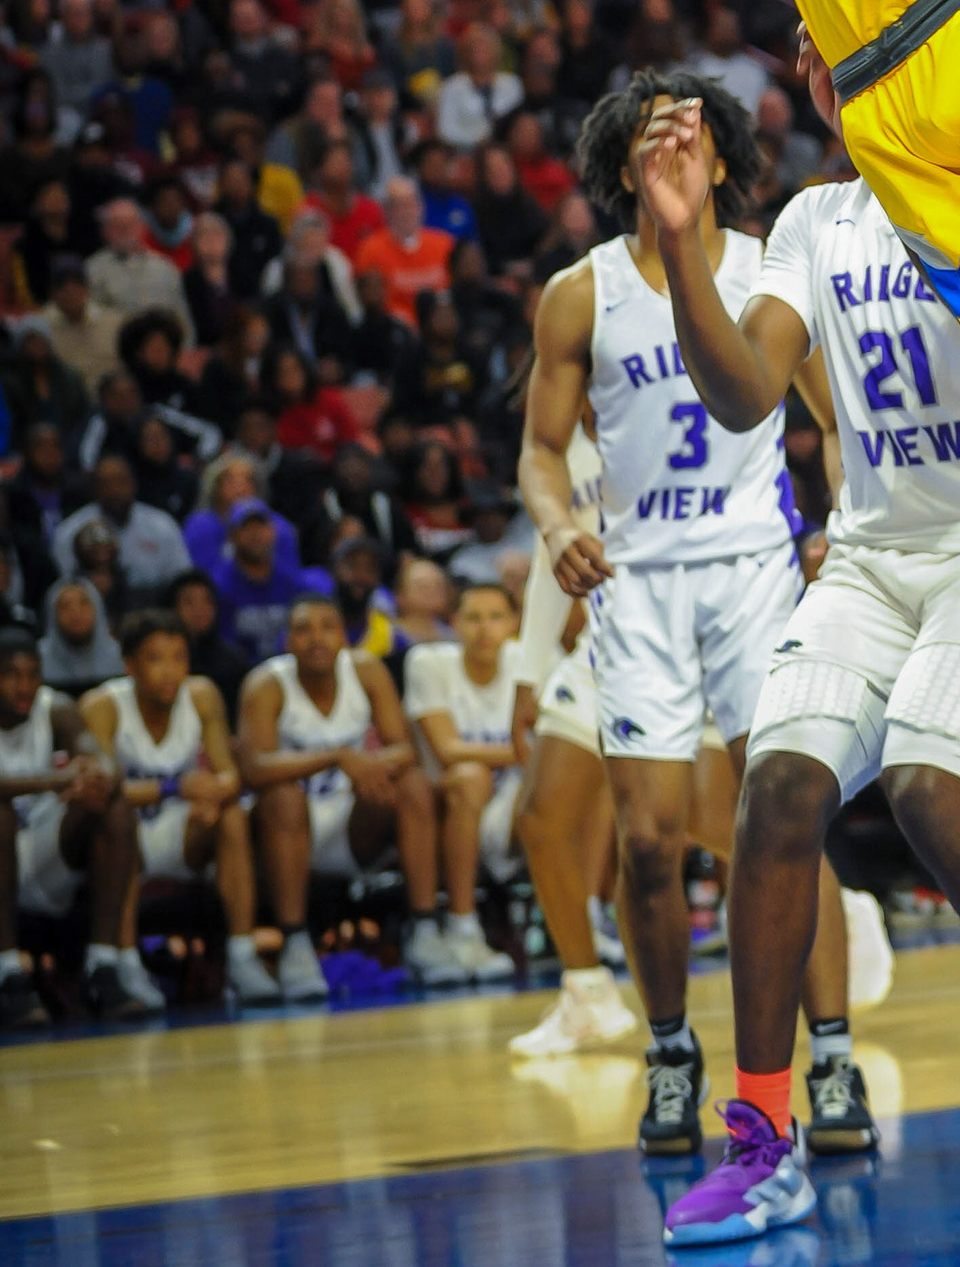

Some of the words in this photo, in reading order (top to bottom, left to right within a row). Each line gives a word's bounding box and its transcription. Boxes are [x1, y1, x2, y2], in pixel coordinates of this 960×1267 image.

[858, 325, 939, 413] 21
[668, 401, 710, 472] 3
[637, 485, 731, 520] VIEW
